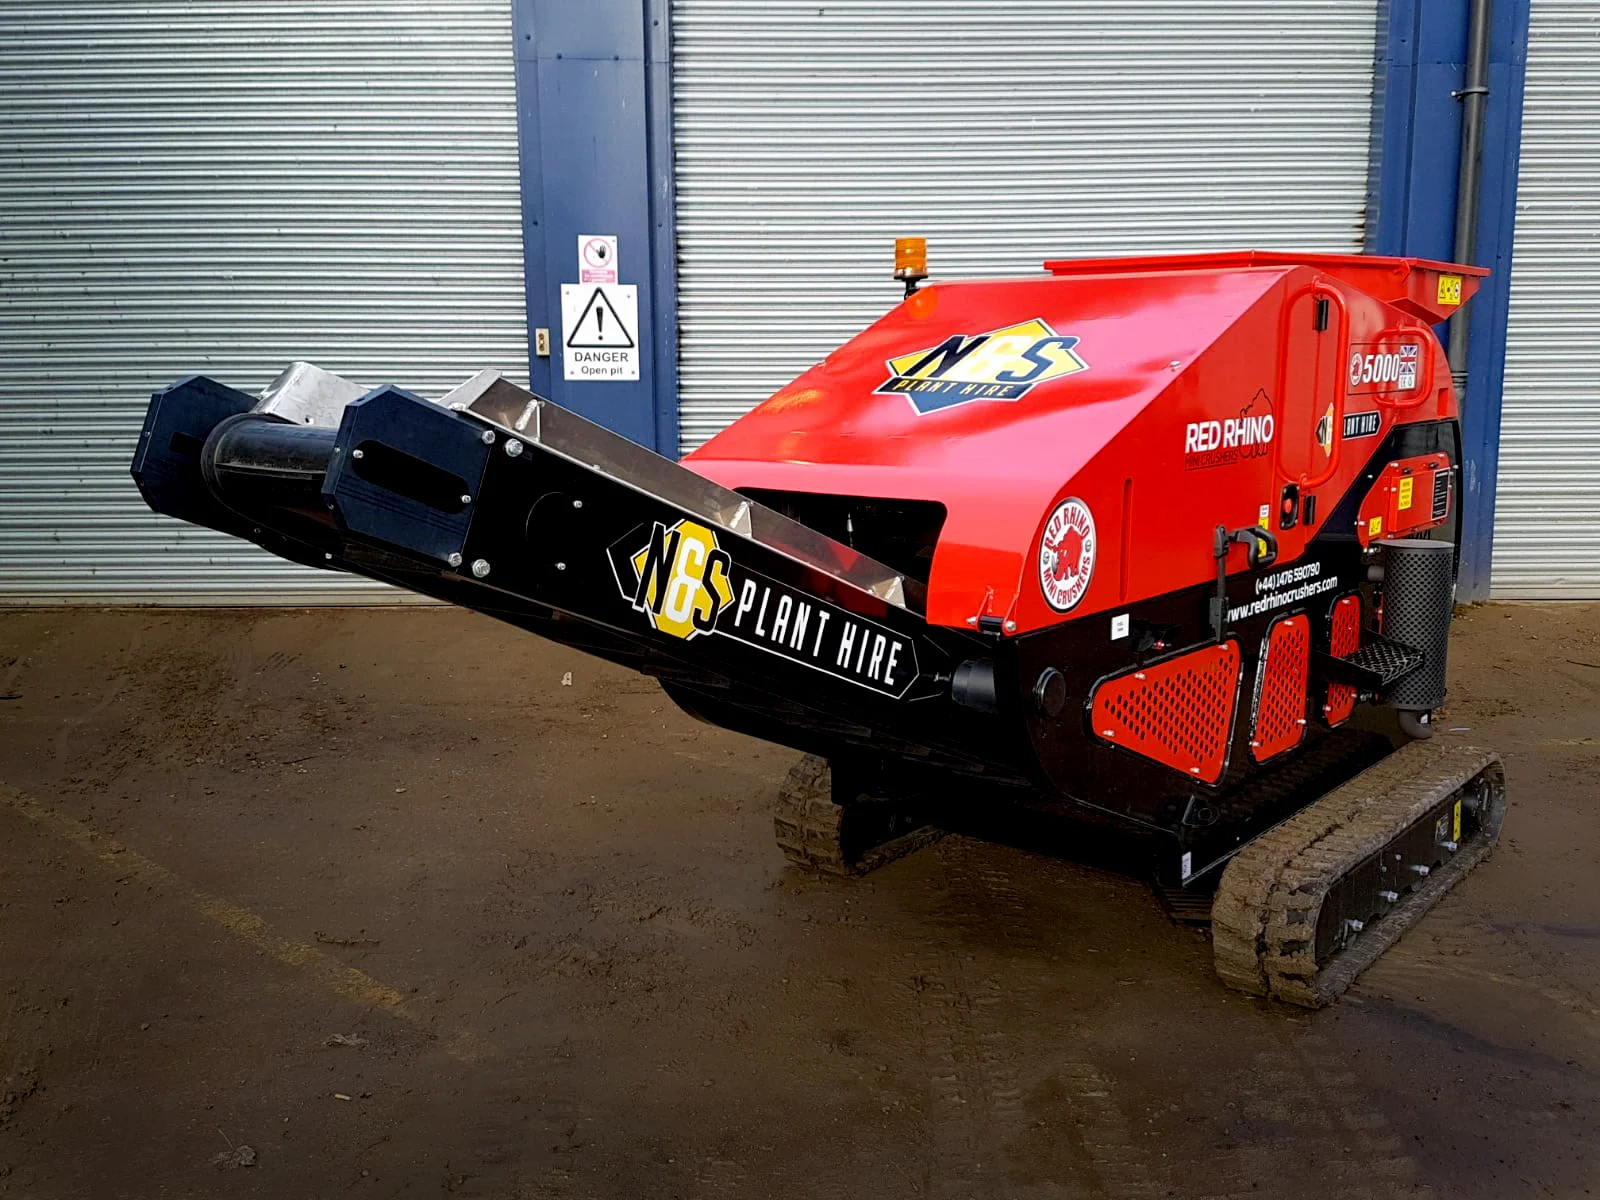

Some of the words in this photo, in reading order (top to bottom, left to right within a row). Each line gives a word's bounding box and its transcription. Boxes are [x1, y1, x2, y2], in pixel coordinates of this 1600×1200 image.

[574, 352, 629, 363] DANGER
[581, 366, 608, 376] Open
[610, 366, 623, 376] pit
[1362, 353, 1400, 384] 5000
[893, 380, 958, 394] PLANT
[960, 383, 1013, 397] HIRE
[1184, 421, 1221, 454] RED
[1223, 415, 1274, 448] RHINO
[1200, 449, 1238, 466] CRUSHERS
[1044, 515, 1062, 550] RED
[1063, 506, 1090, 540] RHINO
[1043, 566, 1058, 599] MINI
[1056, 555, 1091, 605] CRUSHERS
[734, 579, 830, 658] PLANT
[836, 621, 903, 686] HIRE
